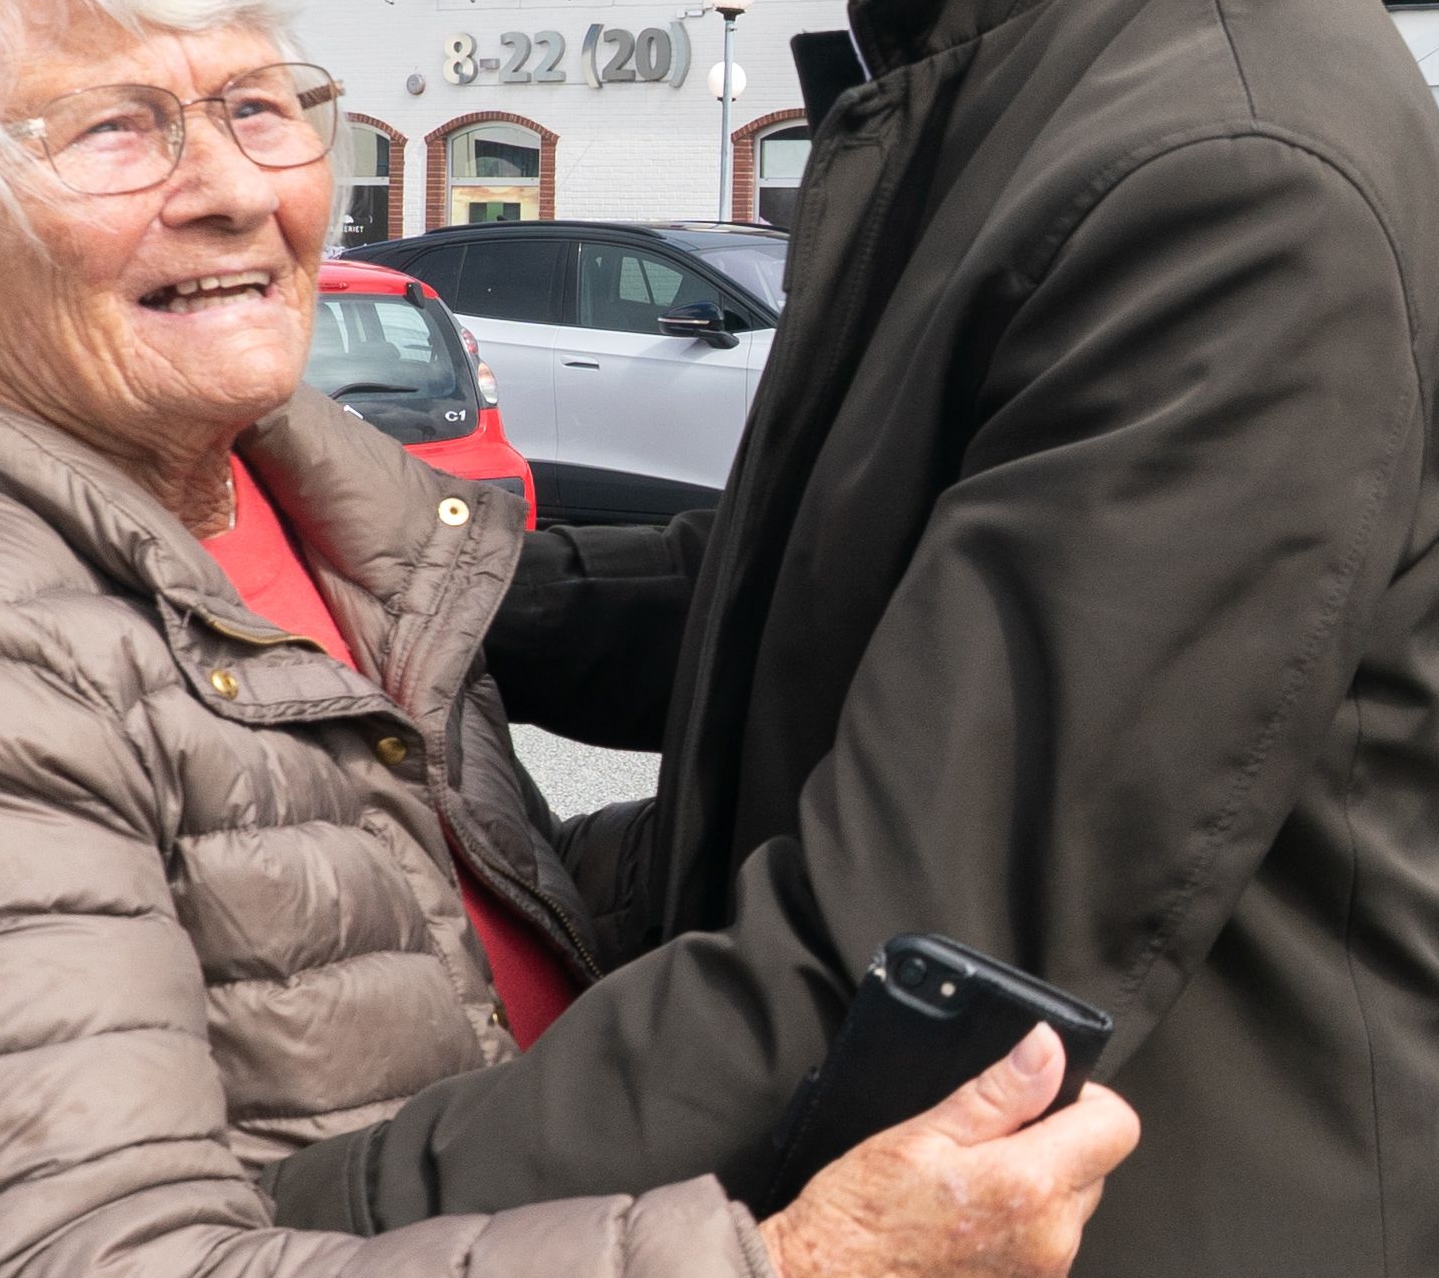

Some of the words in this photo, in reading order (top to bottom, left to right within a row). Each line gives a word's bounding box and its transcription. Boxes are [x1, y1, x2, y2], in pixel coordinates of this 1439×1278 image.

[443, 30, 567, 86] 8-22
[582, 21, 693, 90] (20)
[444, 409, 467, 422] C1
